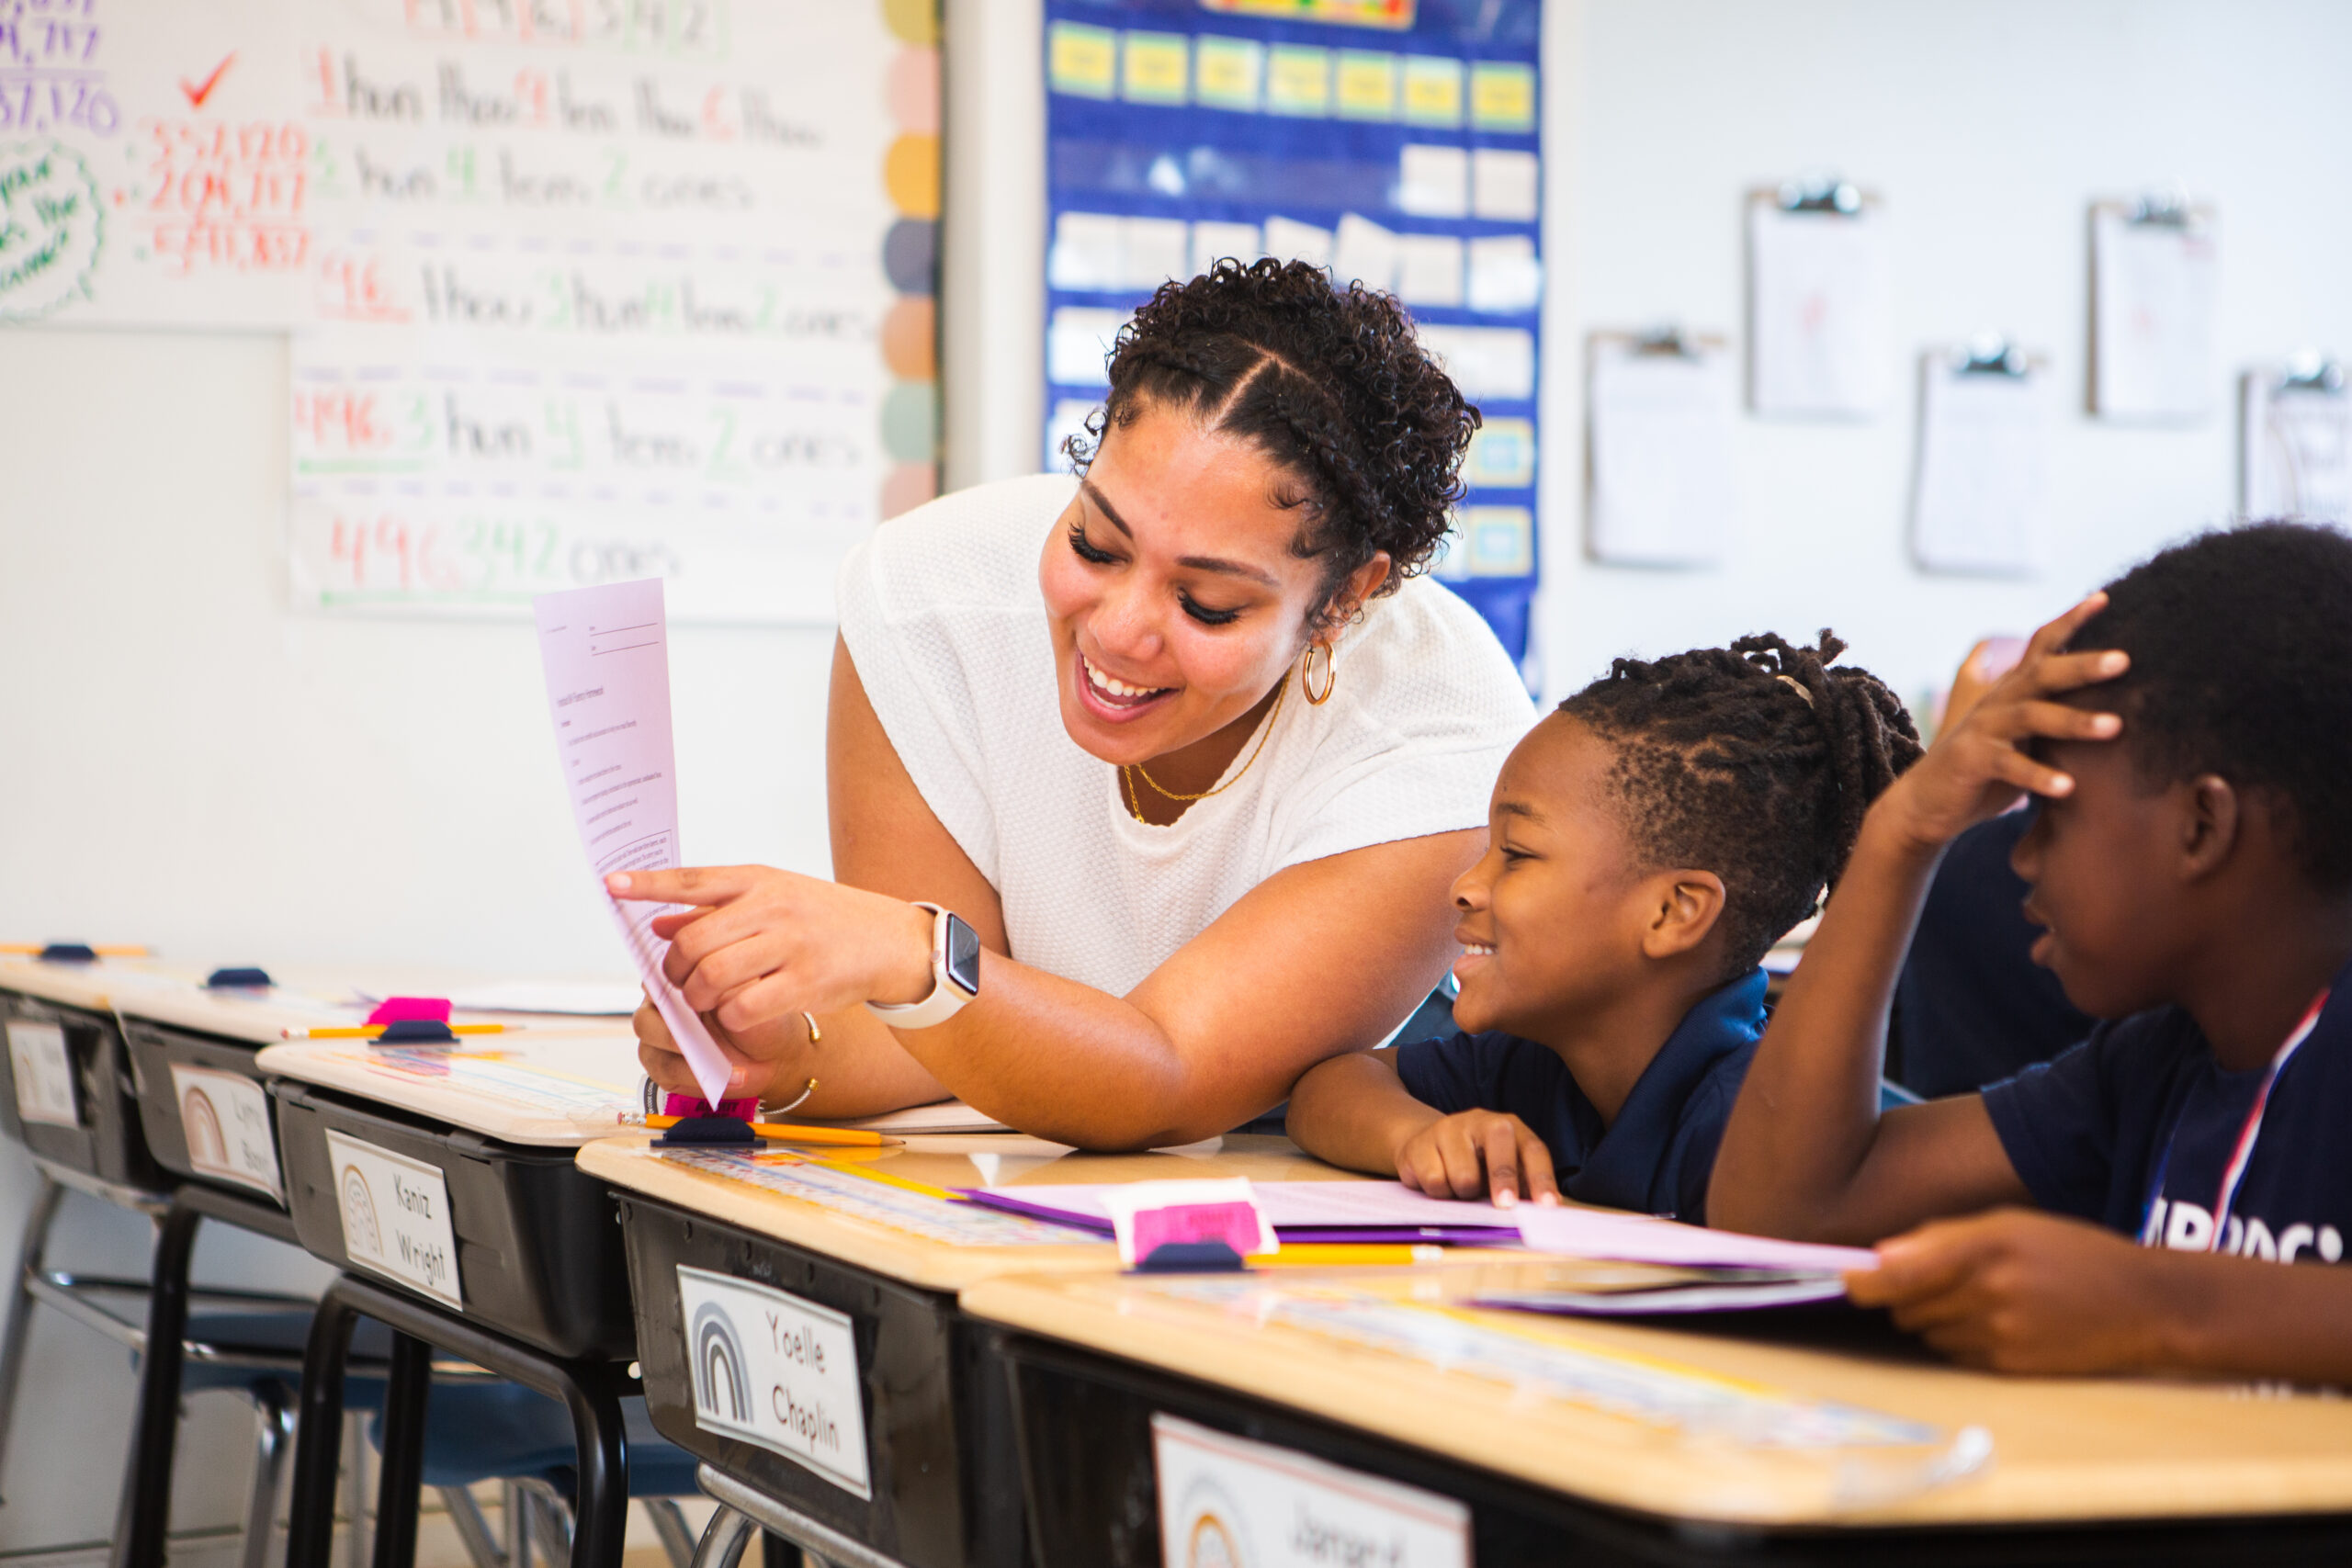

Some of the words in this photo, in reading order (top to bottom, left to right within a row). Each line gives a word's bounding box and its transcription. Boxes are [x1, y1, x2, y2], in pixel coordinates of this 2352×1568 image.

[445, 389, 533, 459] hun
[392, 1173, 433, 1220] Kaniz
[395, 1229, 447, 1287] Wright
[765, 1310, 826, 1374] Yoelle
[772, 1384, 840, 1455] Chaplin
